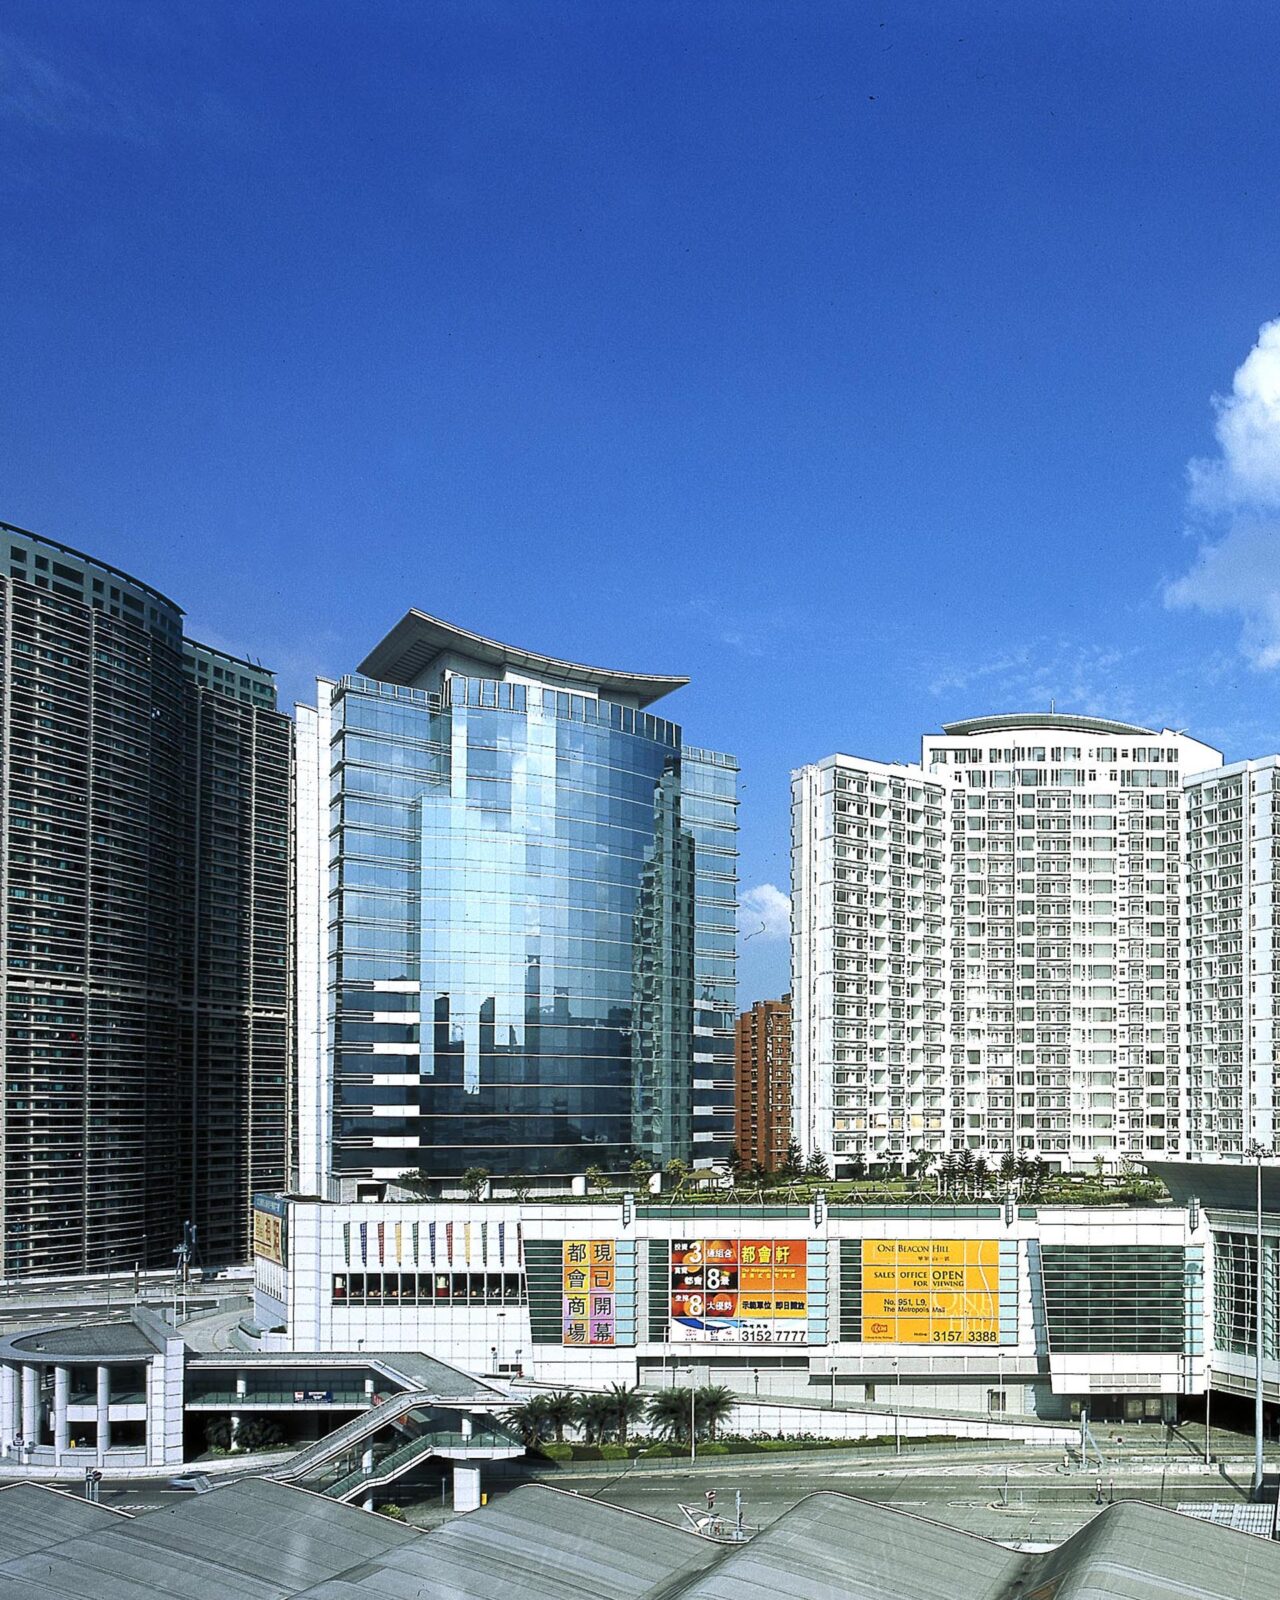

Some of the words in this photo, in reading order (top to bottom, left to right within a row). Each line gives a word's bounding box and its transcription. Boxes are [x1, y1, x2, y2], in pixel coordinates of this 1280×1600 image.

[877, 1244, 896, 1252] ONE
[898, 1244, 929, 1252] BEACON
[742, 1246, 790, 1264] 都會軒
[932, 1270, 964, 1280] OPEN
[568, 1243, 587, 1341] 都會商場
[594, 1244, 612, 1341] 現已開幕
[742, 1330, 772, 1342] 3152
[775, 1330, 806, 1342] 7777
[933, 1330, 962, 1342] 3157
[968, 1330, 996, 1342] 3388
